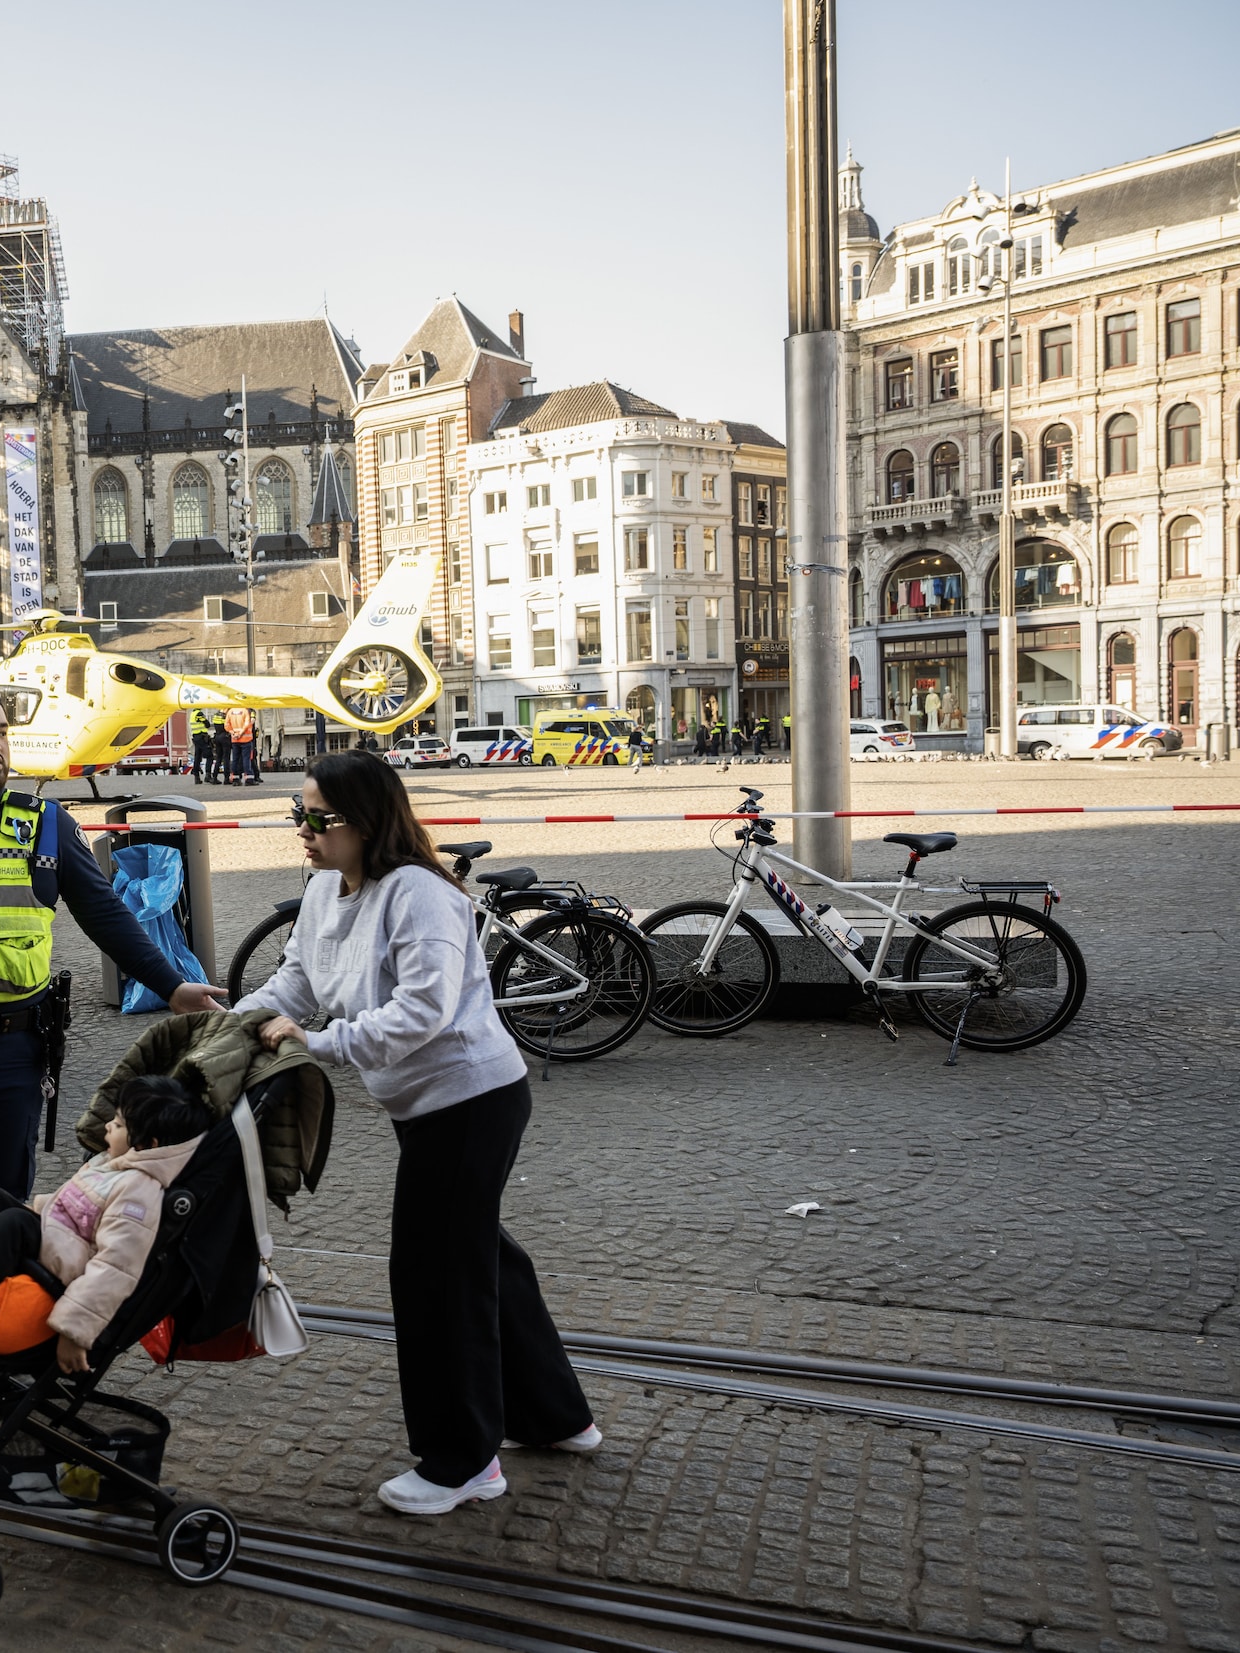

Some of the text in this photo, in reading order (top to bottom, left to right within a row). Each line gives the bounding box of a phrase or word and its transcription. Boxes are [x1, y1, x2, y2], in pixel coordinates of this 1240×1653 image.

[9, 480, 35, 509] HOERA
[14, 512, 32, 521] HET
[14, 527, 34, 537] DAK
[15, 542, 34, 552] VAN
[20, 558, 32, 566] DE
[13, 572, 38, 582] STAD
[22, 588, 31, 597] IS
[14, 599, 40, 616] OPEN
[378, 604, 417, 615] anwb
[808, 915, 835, 944] POLITIE
